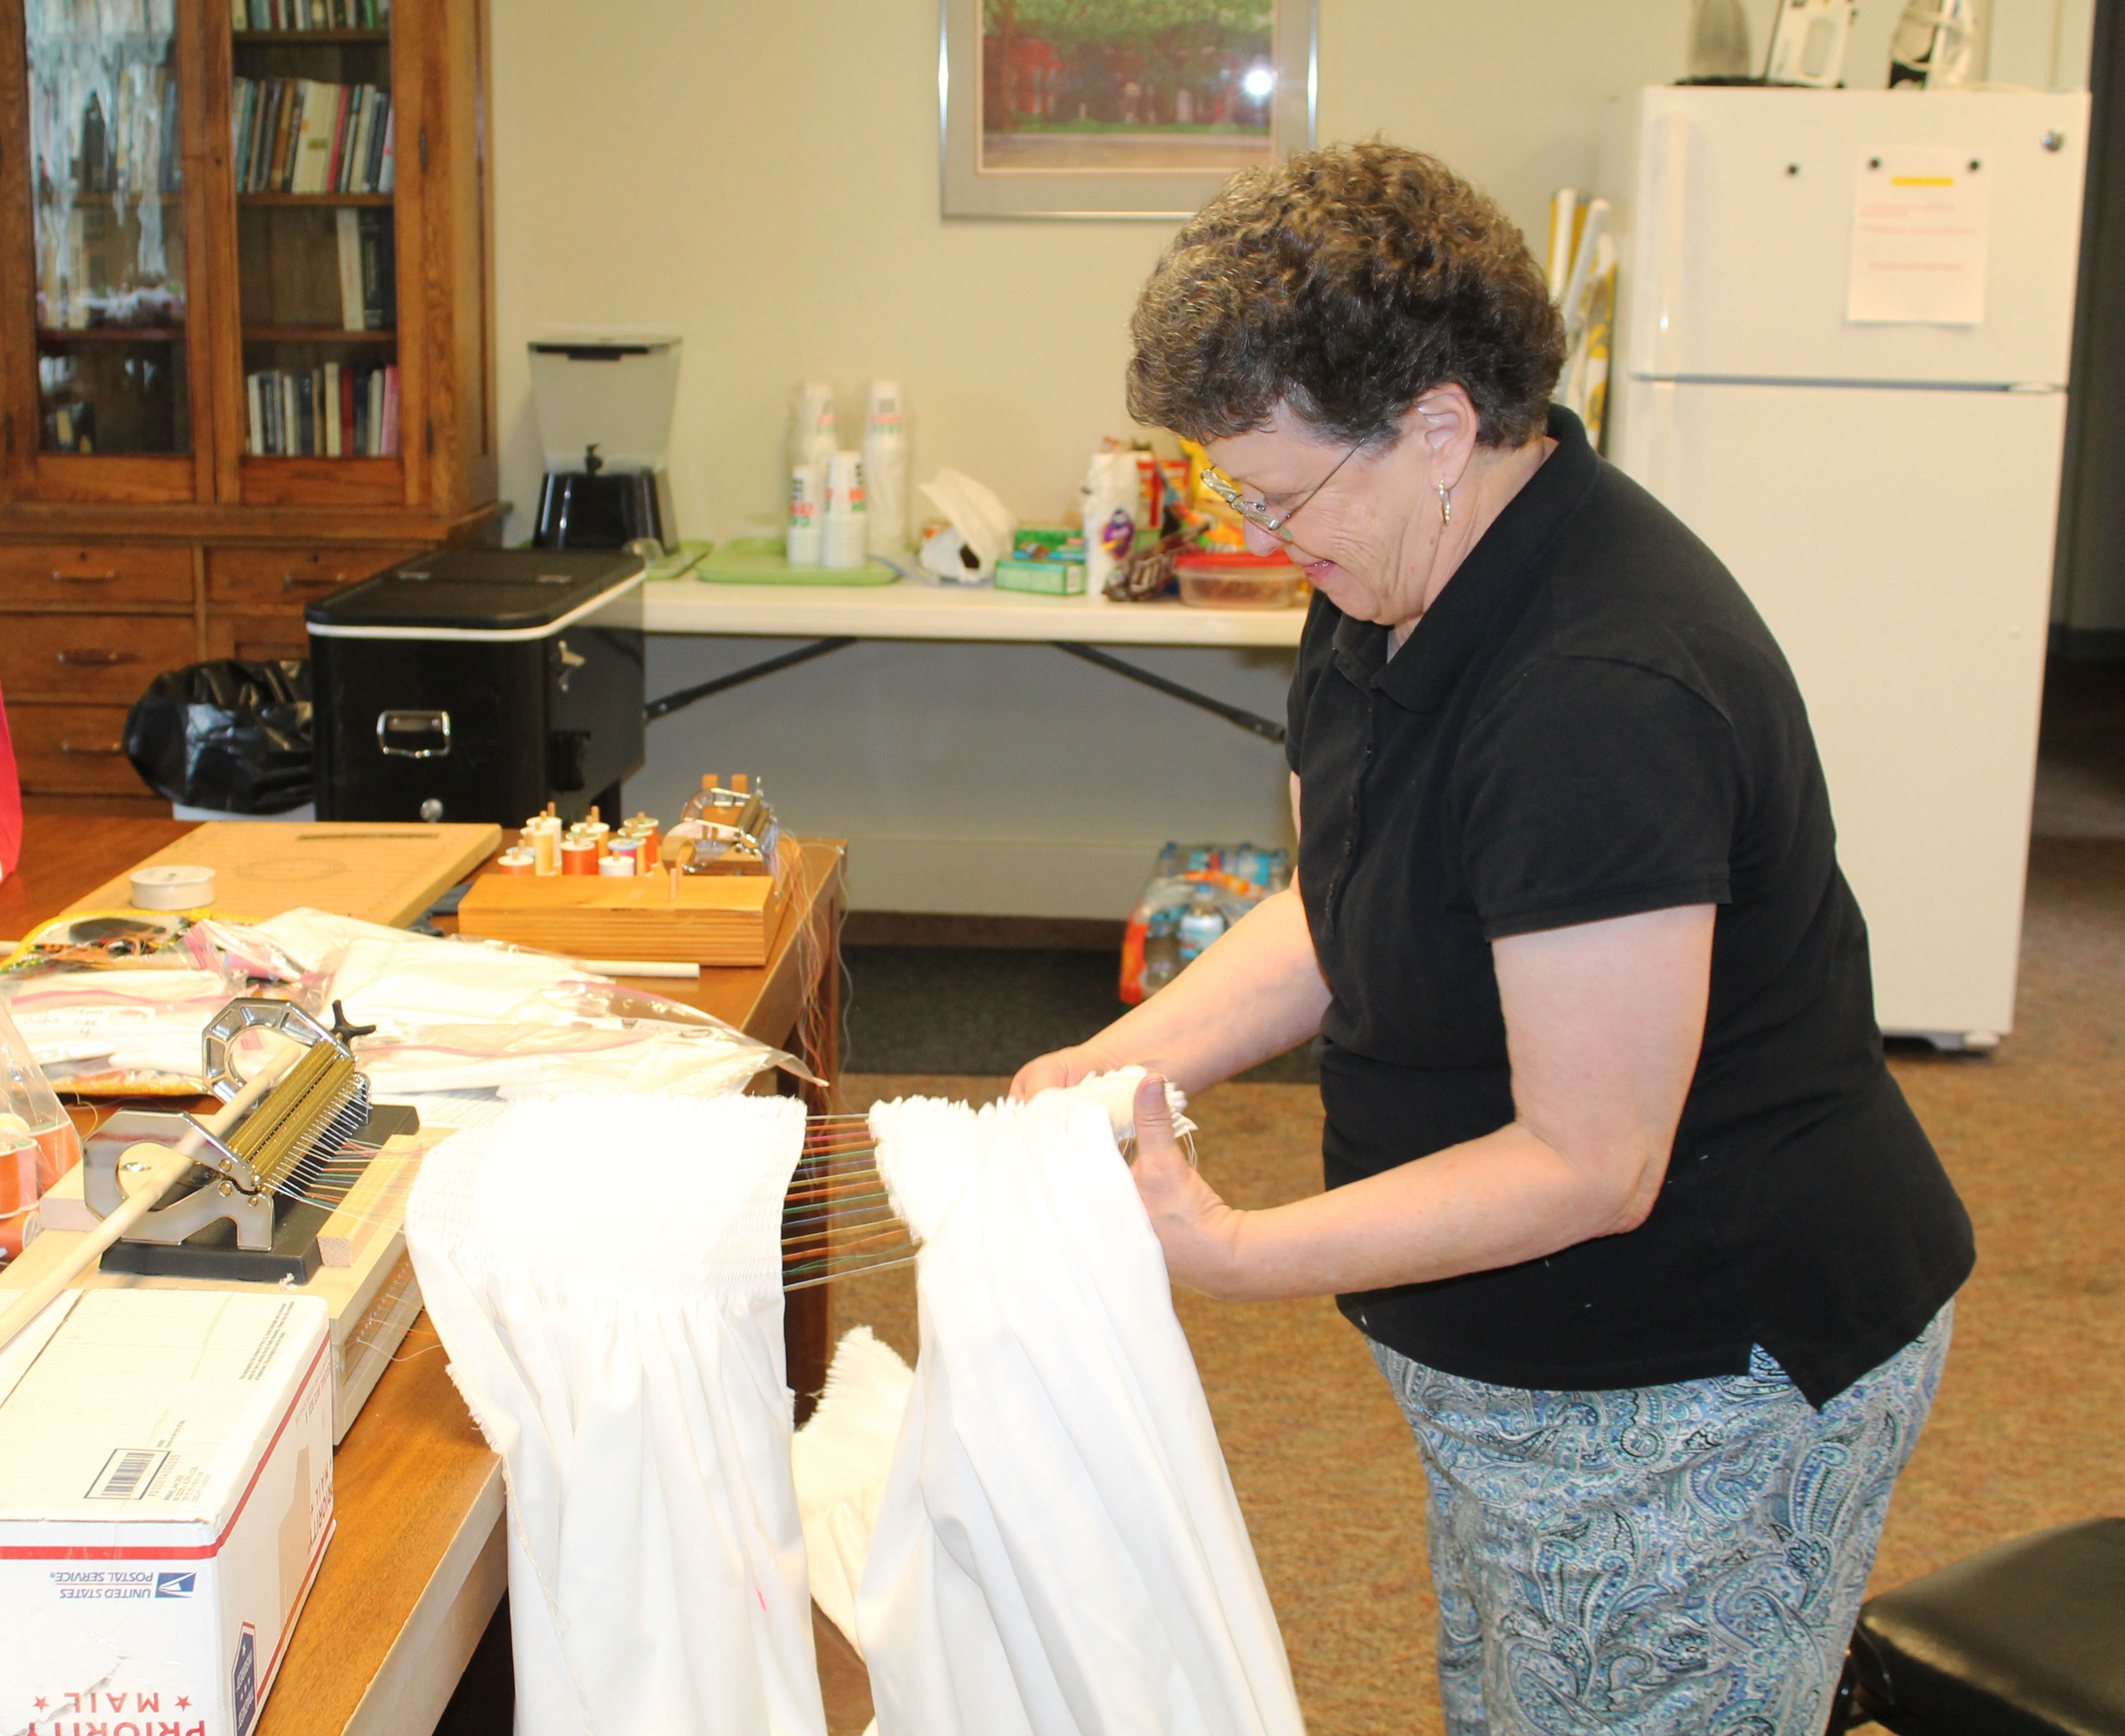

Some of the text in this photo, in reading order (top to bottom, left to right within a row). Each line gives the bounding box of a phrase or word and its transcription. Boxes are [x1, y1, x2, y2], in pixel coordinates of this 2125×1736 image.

[109, 1572, 153, 1582] POSTAL
[60, 1588, 150, 1599] UNITED STATES
[64, 1692, 160, 1713] MAIL
